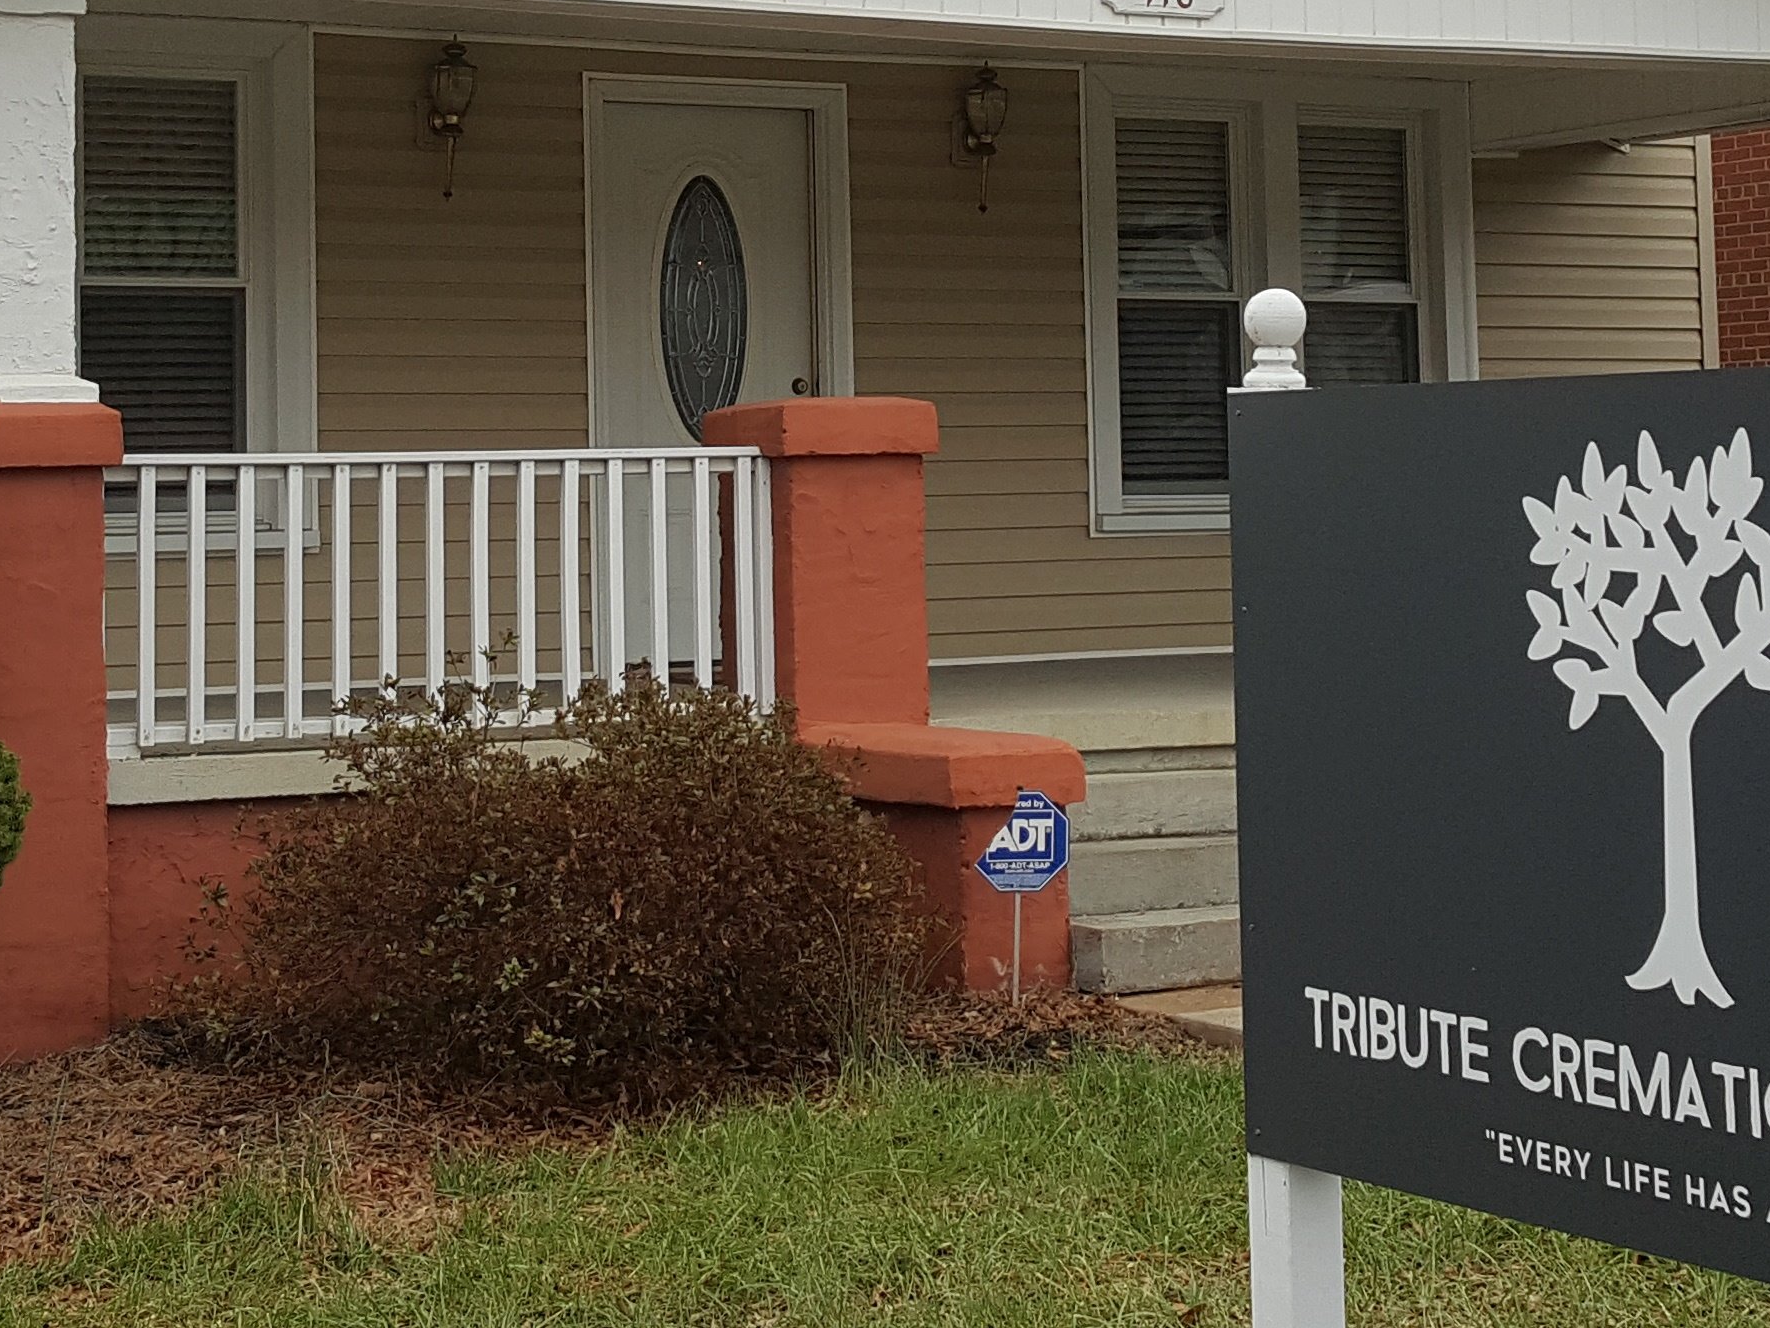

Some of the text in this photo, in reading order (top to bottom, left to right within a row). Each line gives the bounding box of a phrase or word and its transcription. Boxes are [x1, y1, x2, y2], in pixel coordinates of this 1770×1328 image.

[989, 818, 1054, 852] ADT
[1033, 800, 1045, 809] by
[1304, 986, 1490, 1083] TRIBUTE
[1485, 1129, 1591, 1180] "EVERY
[1605, 1156, 1671, 1200] LIFE
[1685, 1174, 1751, 1218] HAS
